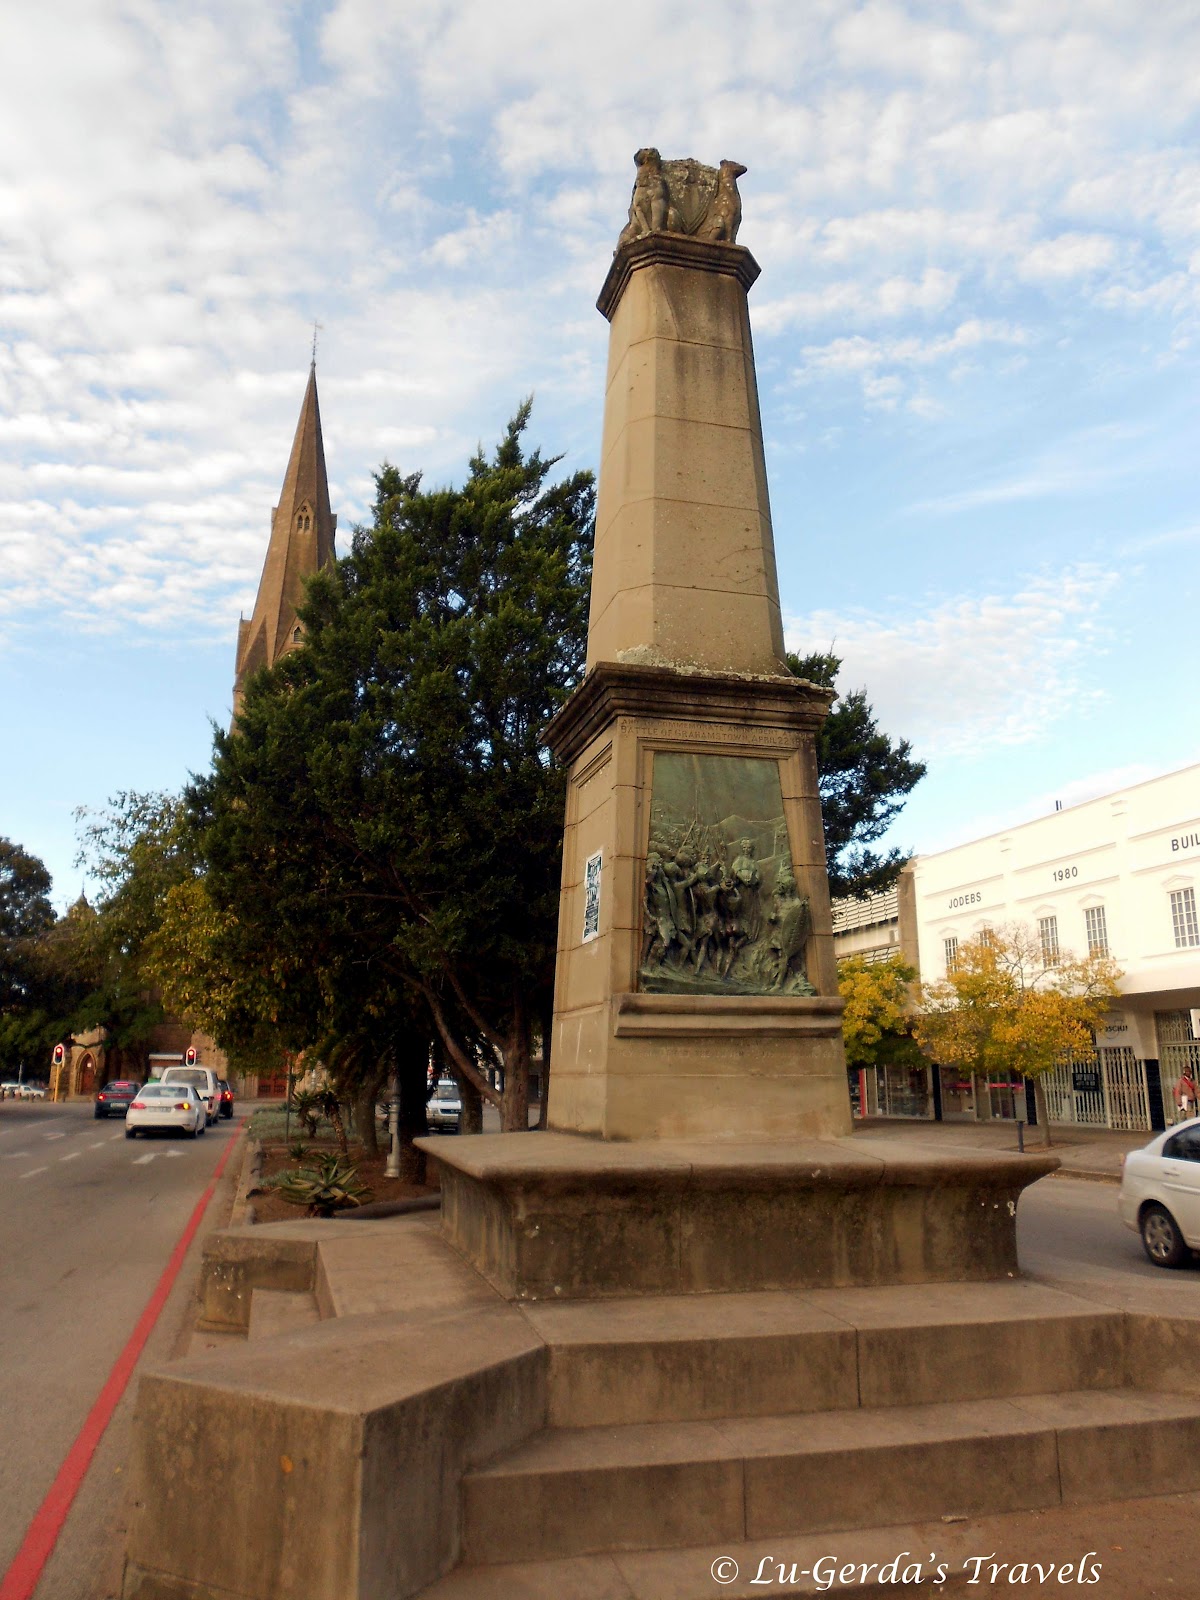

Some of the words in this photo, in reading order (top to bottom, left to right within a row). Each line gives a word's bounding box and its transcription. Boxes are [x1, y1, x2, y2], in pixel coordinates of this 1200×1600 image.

[620, 726, 658, 736] BATTLE
[660, 728, 673, 737] OF
[751, 734, 778, 745] APRIL
[948, 891, 982, 909] JODEBS
[1052, 866, 1079, 882] 1980
[1171, 832, 1200, 852] BUIL
